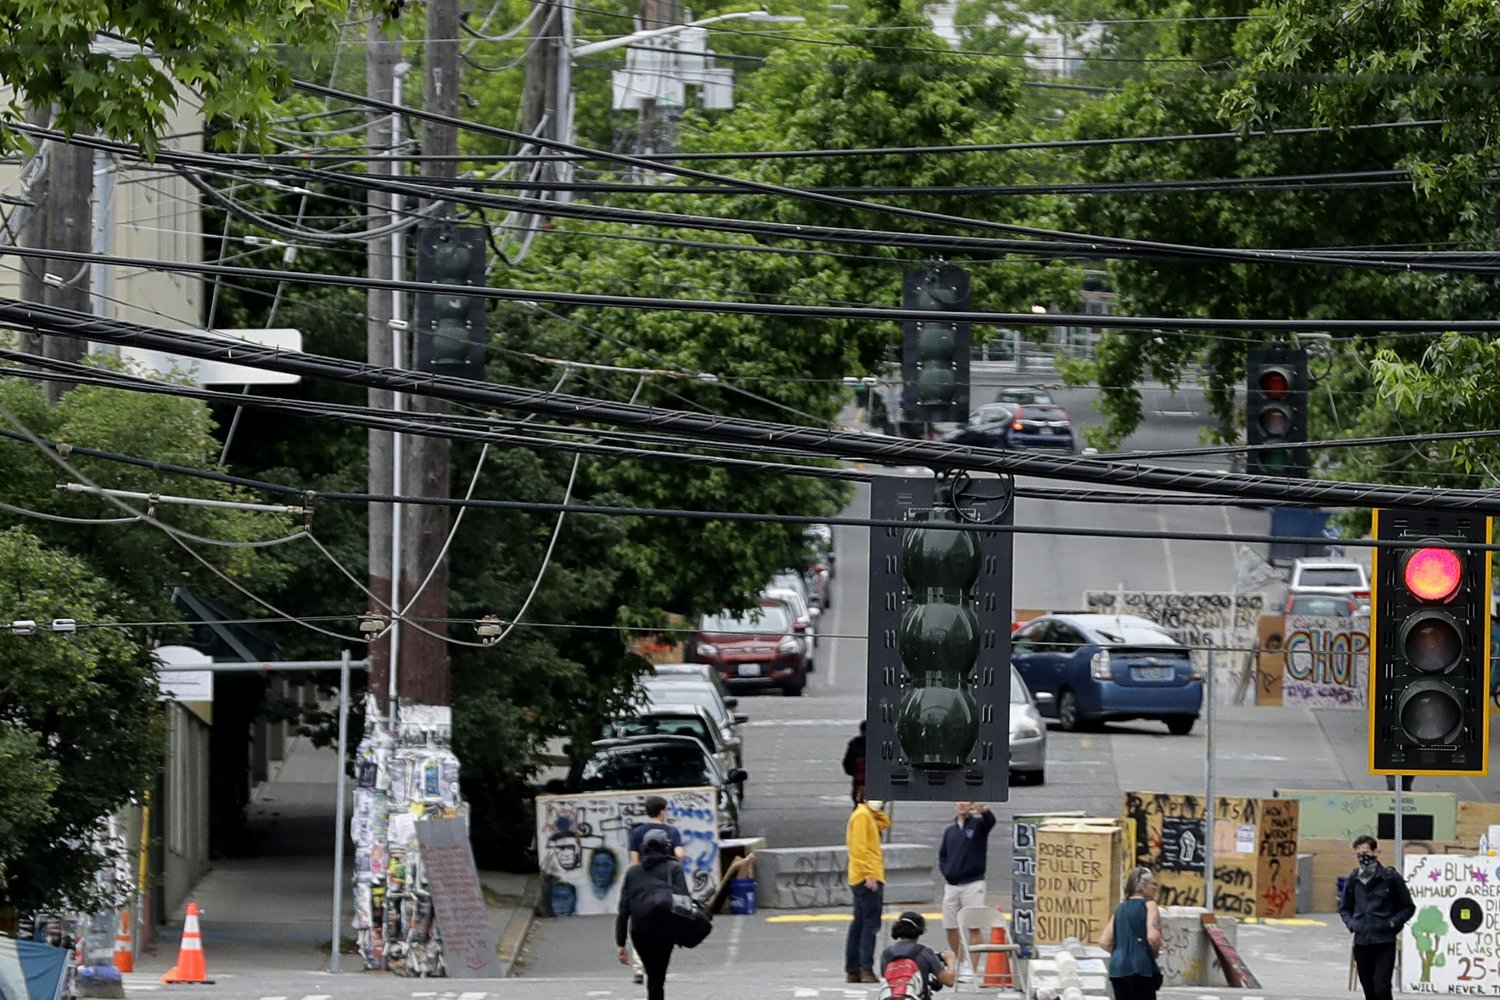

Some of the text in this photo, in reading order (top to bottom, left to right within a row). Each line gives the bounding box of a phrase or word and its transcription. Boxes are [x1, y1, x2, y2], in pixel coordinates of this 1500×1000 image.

[1286, 630, 1371, 688] CHOP
[1038, 842, 1098, 860] ROBERT
[1037, 858, 1103, 877] FULLER
[1444, 863, 1474, 882] BLM
[1038, 878, 1098, 894] DID NOT
[1409, 885, 1458, 898] AHMAUD
[1037, 896, 1101, 916] COMMIT
[1037, 916, 1101, 944] SUICIDE
[1475, 932, 1493, 946] TO
[1447, 942, 1462, 956] HE
[1467, 943, 1492, 957] WAS
[1410, 983, 1438, 992] WILL
[1448, 984, 1485, 994] NEVER
